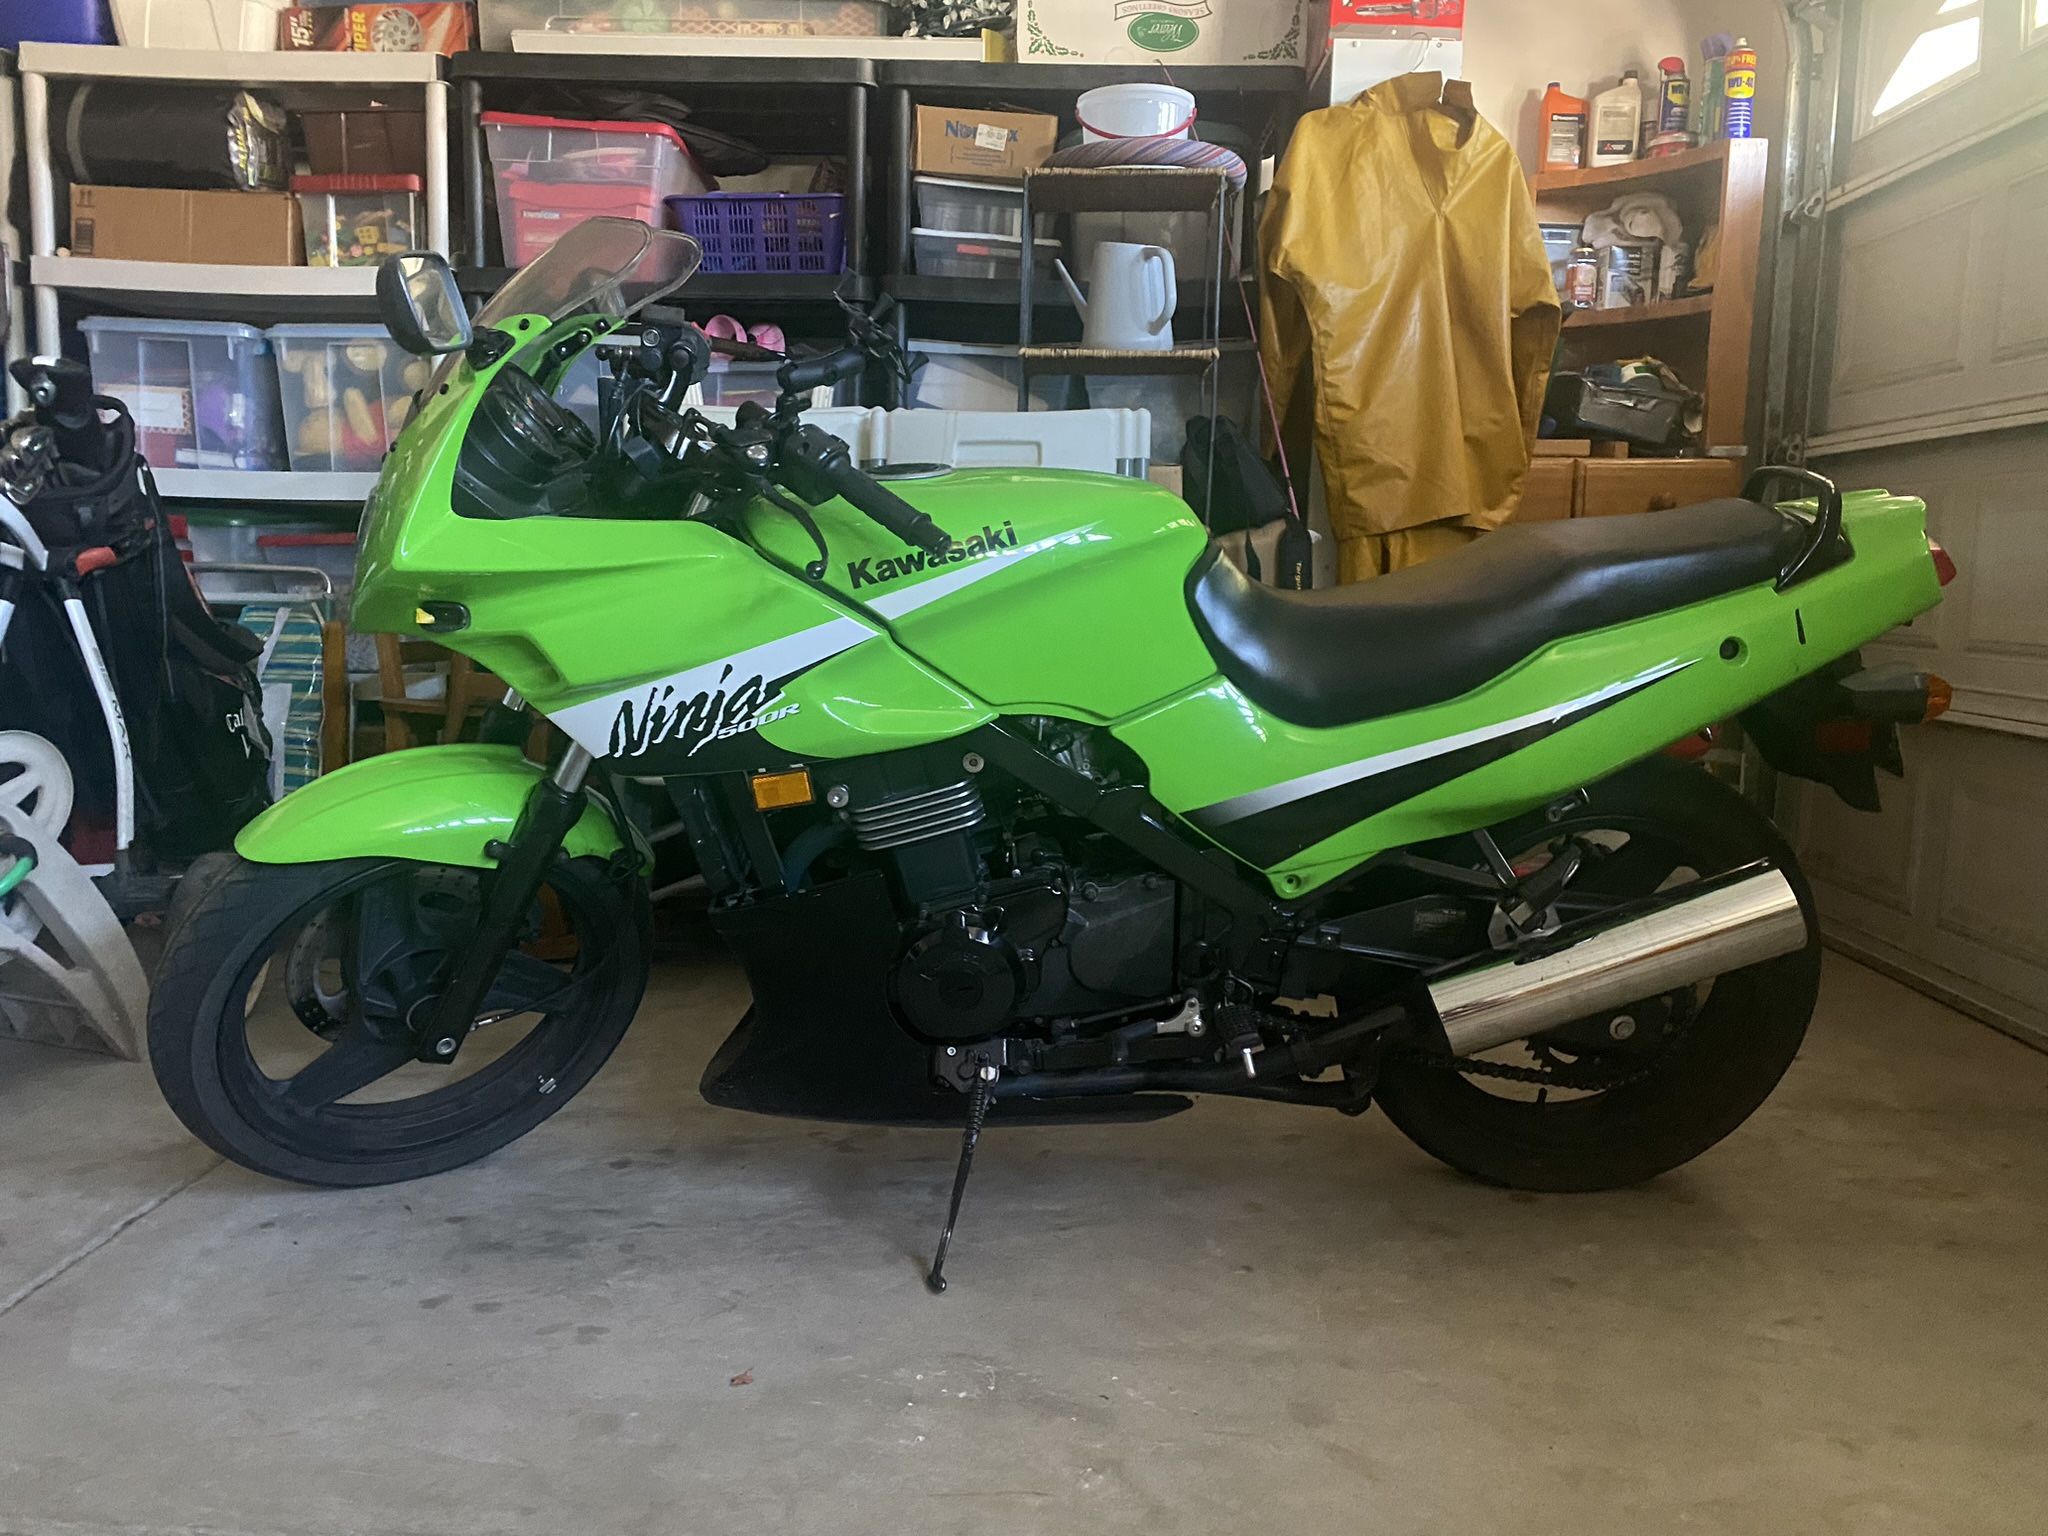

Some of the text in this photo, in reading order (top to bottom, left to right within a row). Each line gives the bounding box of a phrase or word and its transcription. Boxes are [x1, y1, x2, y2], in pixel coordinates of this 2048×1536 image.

[847, 520, 1019, 590] Kawasaki
[608, 663, 775, 758] Ninja
[716, 702, 801, 740] 500R
